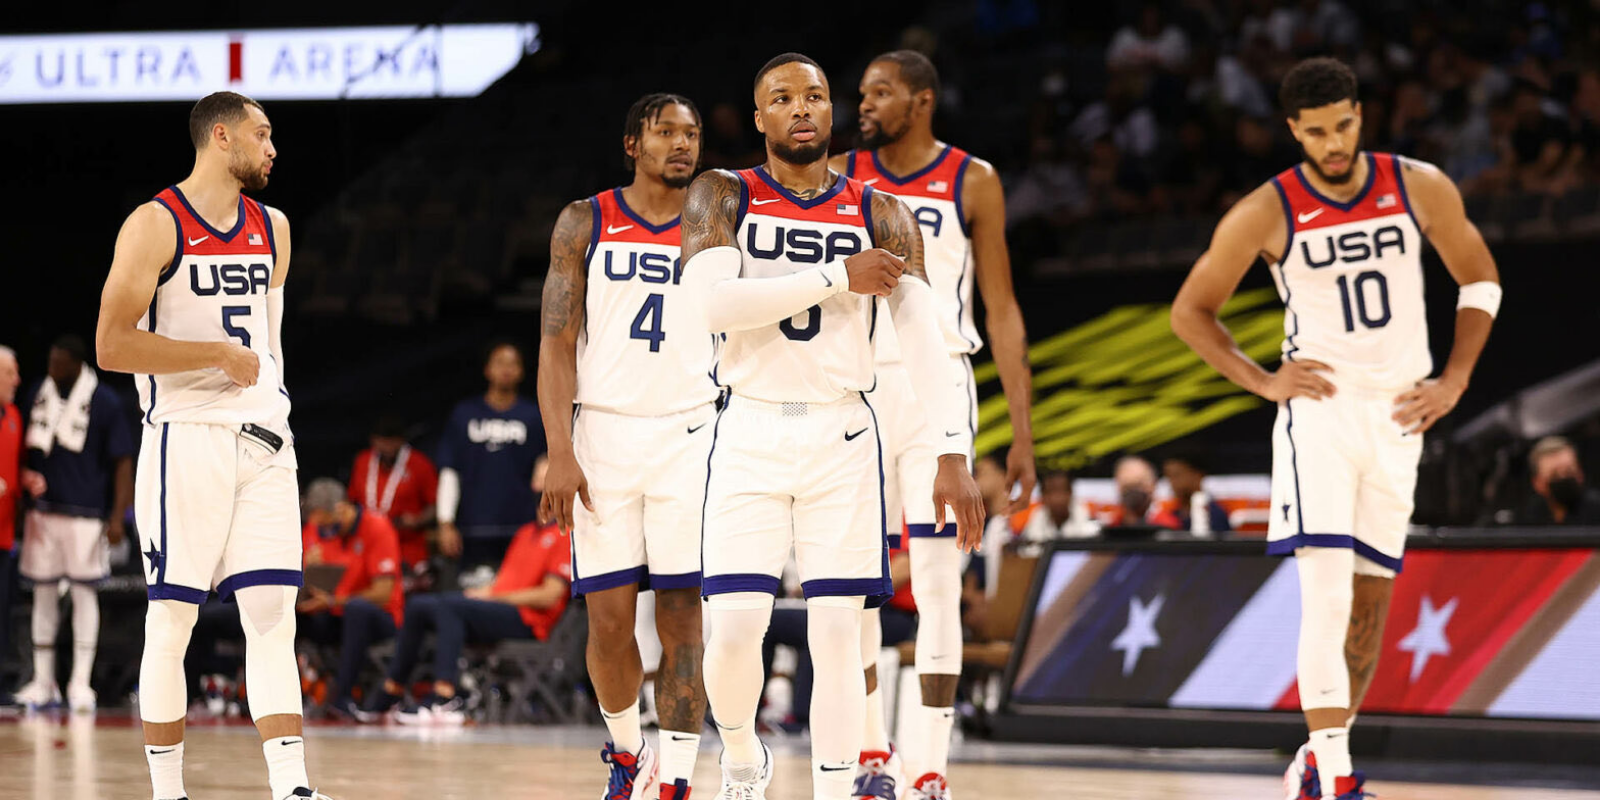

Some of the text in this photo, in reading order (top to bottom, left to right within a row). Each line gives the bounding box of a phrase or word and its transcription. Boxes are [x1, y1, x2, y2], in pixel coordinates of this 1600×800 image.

[35, 45, 201, 87] ULTRA
[269, 41, 438, 82] ARENA
[746, 222, 862, 264] USA
[1300, 225, 1406, 269] USA
[189, 263, 270, 297] USA
[604, 250, 681, 286] US
[629, 292, 666, 353] 4
[1336, 270, 1392, 333] 10
[221, 305, 252, 349] 5
